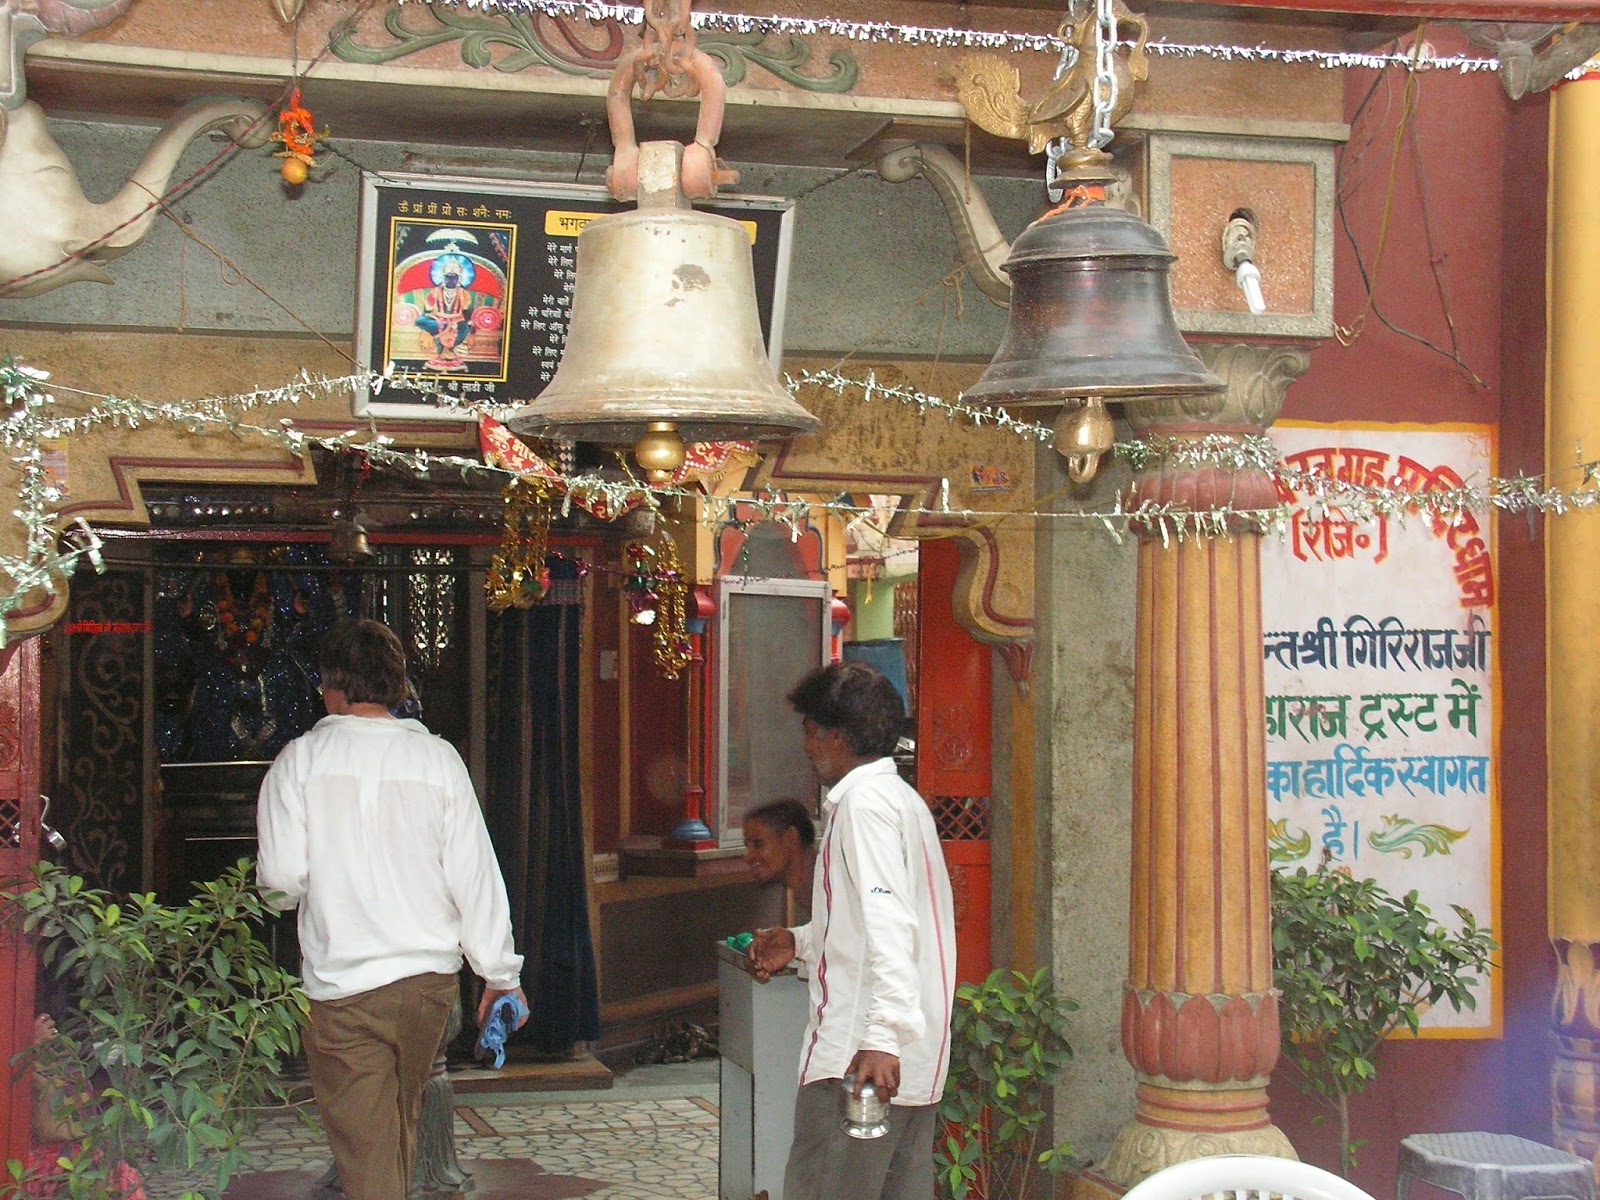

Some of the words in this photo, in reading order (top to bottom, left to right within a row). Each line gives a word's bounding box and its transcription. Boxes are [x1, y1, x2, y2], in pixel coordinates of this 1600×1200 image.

[495, 209, 513, 220] नमः
[1359, 693, 1438, 741] ट्रस्ट
[1444, 678, 1483, 738] में
[1397, 755, 1490, 797] स्वागत
